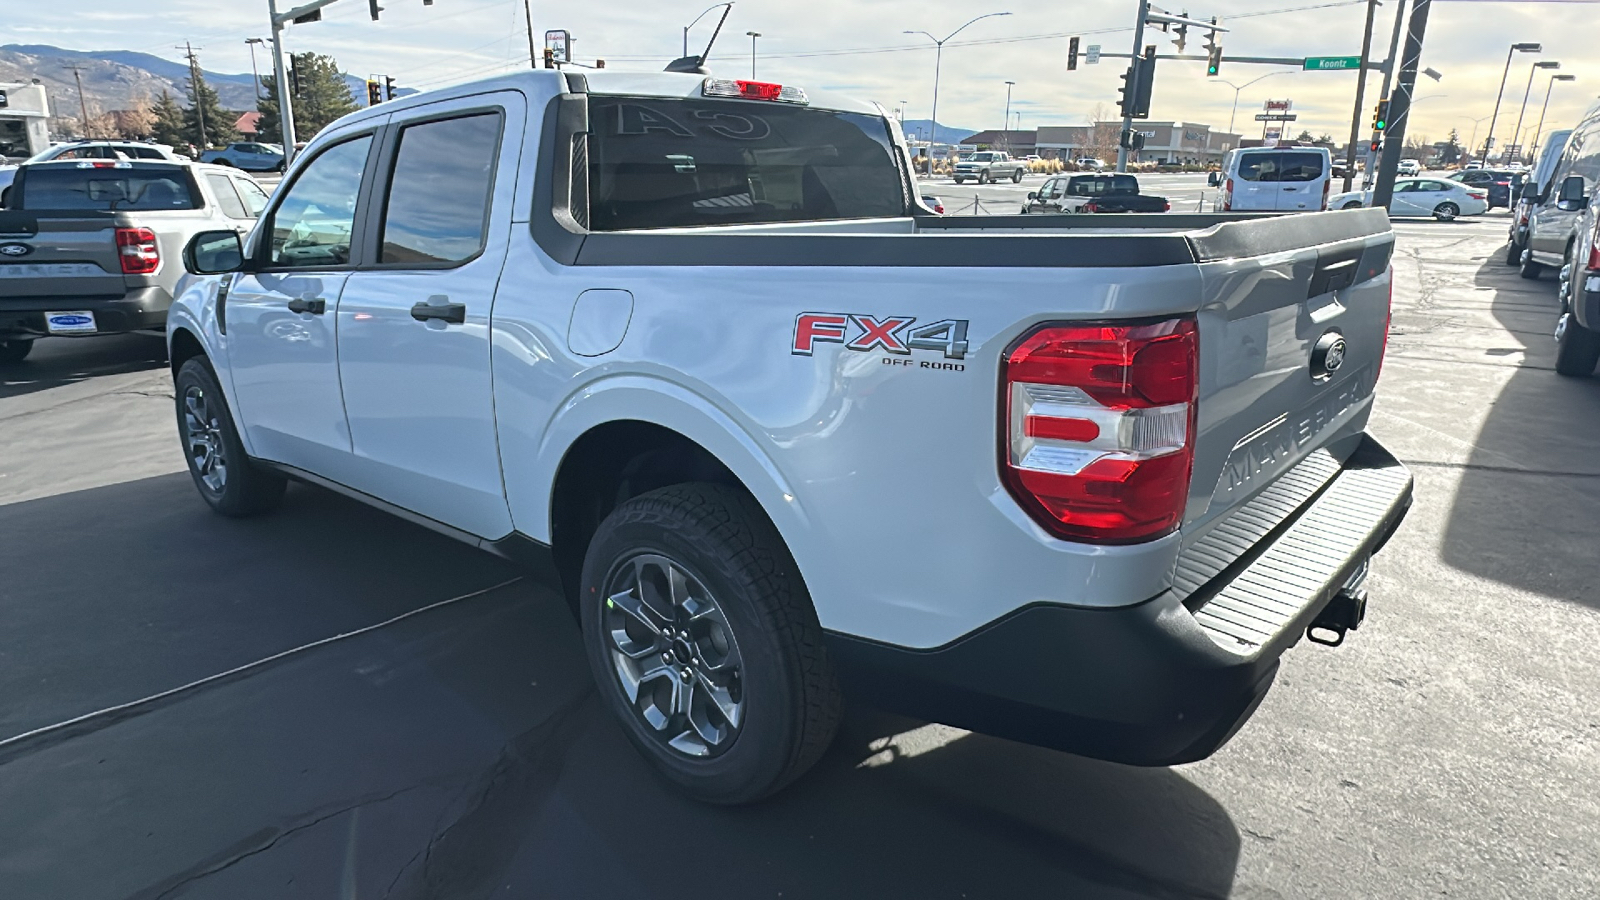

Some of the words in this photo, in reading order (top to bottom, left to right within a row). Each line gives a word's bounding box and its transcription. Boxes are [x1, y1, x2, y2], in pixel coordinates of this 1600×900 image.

[1319, 59, 1348, 68] Koontz
[791, 311, 969, 360] FX4
[882, 357, 914, 367] OFF
[920, 360, 965, 372] ROAD
[1226, 381, 1359, 492] MAVERICK
